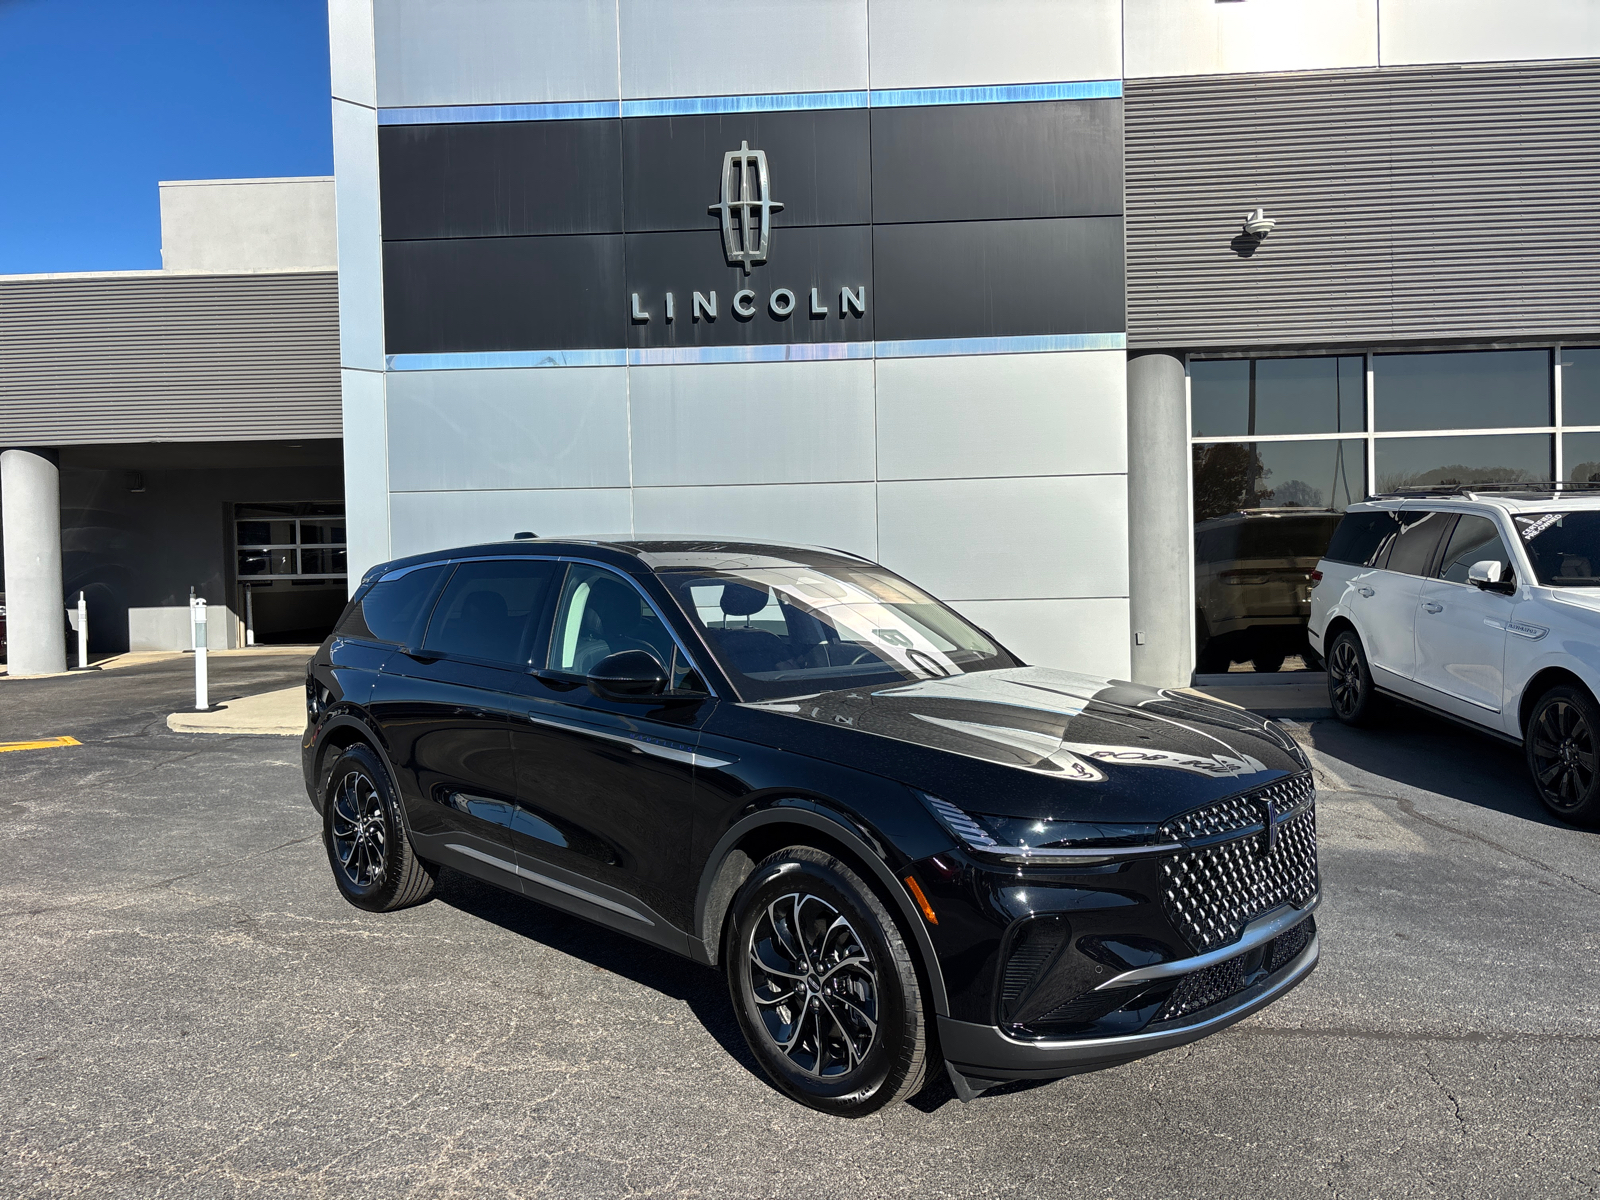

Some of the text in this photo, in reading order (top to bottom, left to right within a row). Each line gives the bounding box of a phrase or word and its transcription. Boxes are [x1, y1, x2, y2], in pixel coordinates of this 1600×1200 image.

[631, 286, 865, 320] LINCOLN
[1522, 513, 1553, 536] CERTIFIED
[1525, 514, 1562, 540] PRE-OWNED
